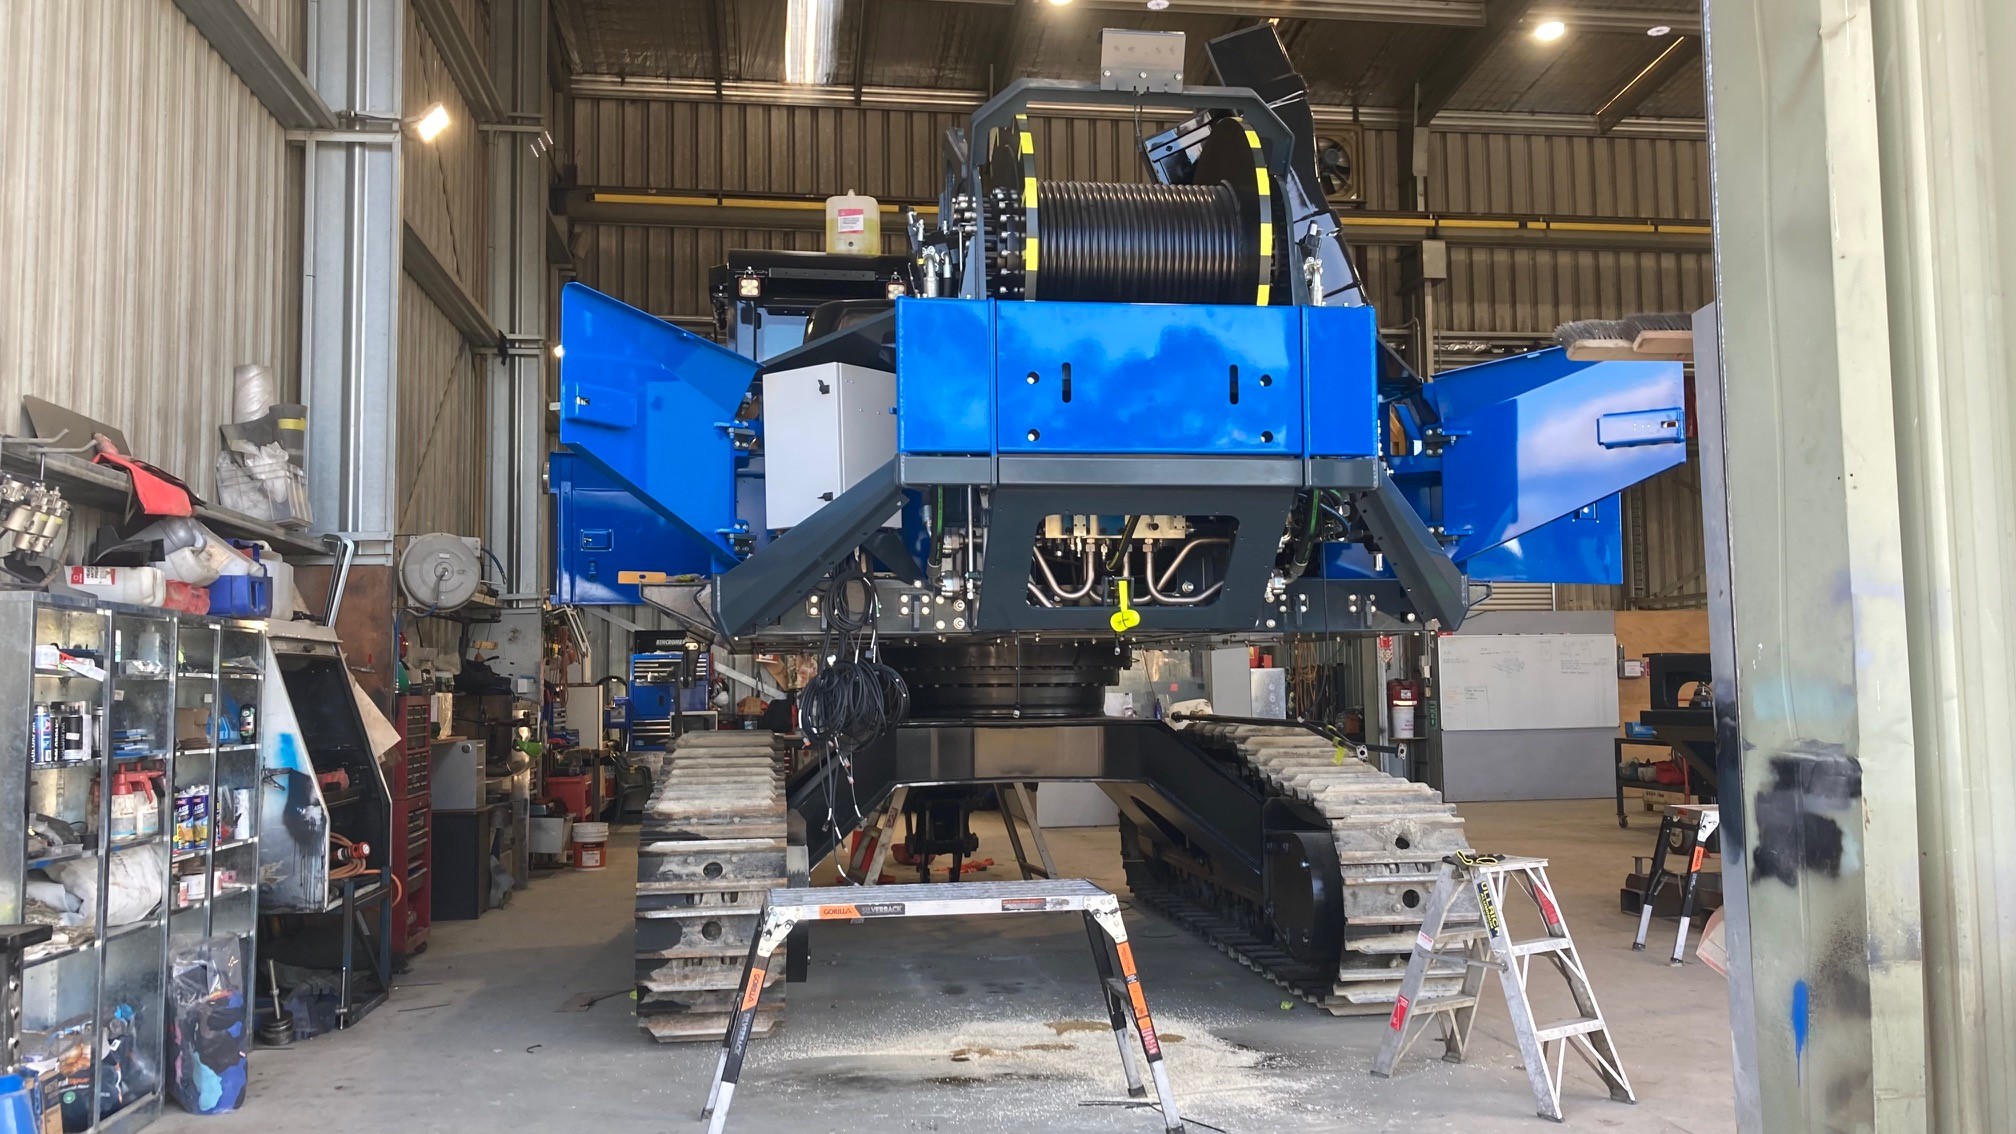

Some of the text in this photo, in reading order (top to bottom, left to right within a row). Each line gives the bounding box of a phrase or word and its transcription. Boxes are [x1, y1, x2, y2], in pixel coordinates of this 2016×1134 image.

[823, 905, 903, 915] GORILLA SILVERBACK
[748, 973, 760, 1003] GORILLA
